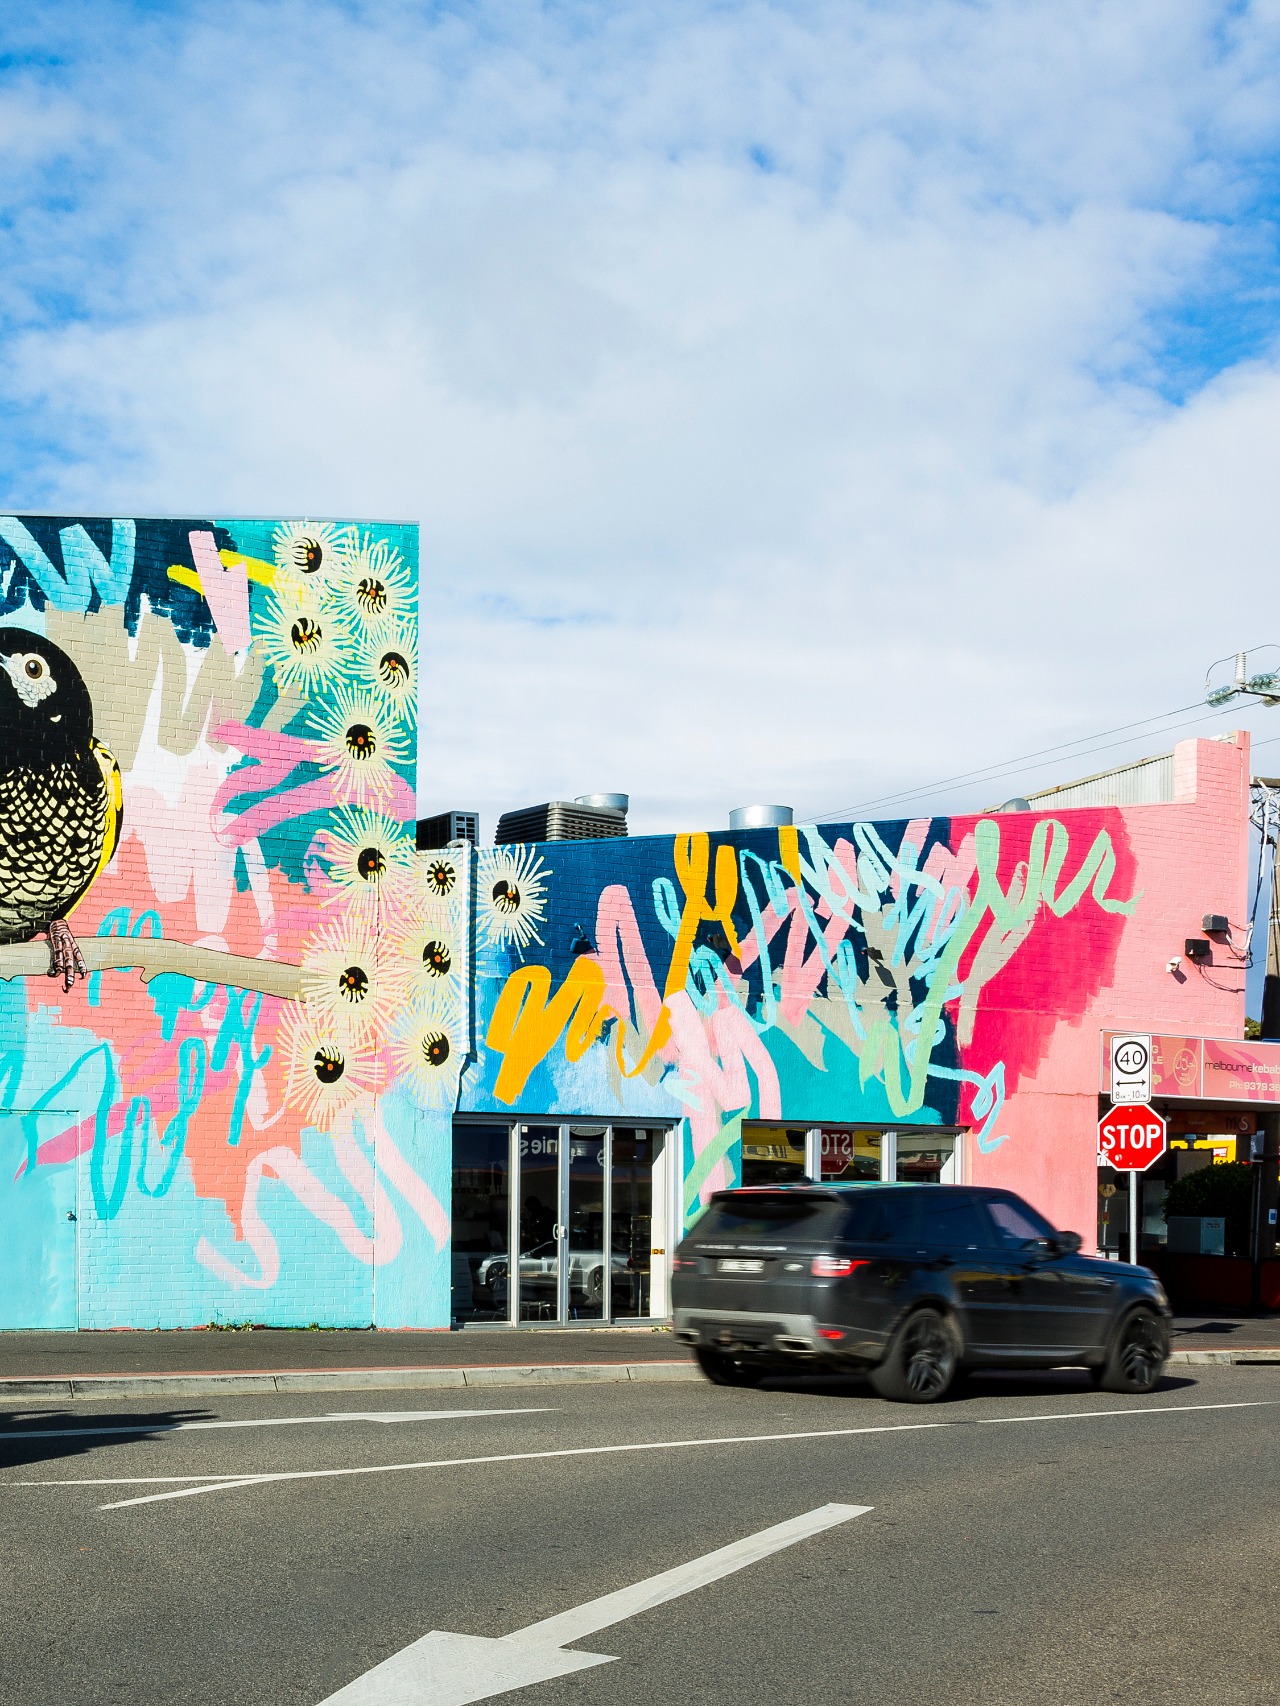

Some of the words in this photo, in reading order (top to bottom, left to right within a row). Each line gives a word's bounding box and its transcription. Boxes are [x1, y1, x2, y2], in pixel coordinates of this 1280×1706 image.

[1120, 1050, 1143, 1066] 40
[1229, 1080, 1243, 1090] Ph:
[1244, 1081, 1268, 1091] 9379
[1102, 1124, 1161, 1150] STOP
